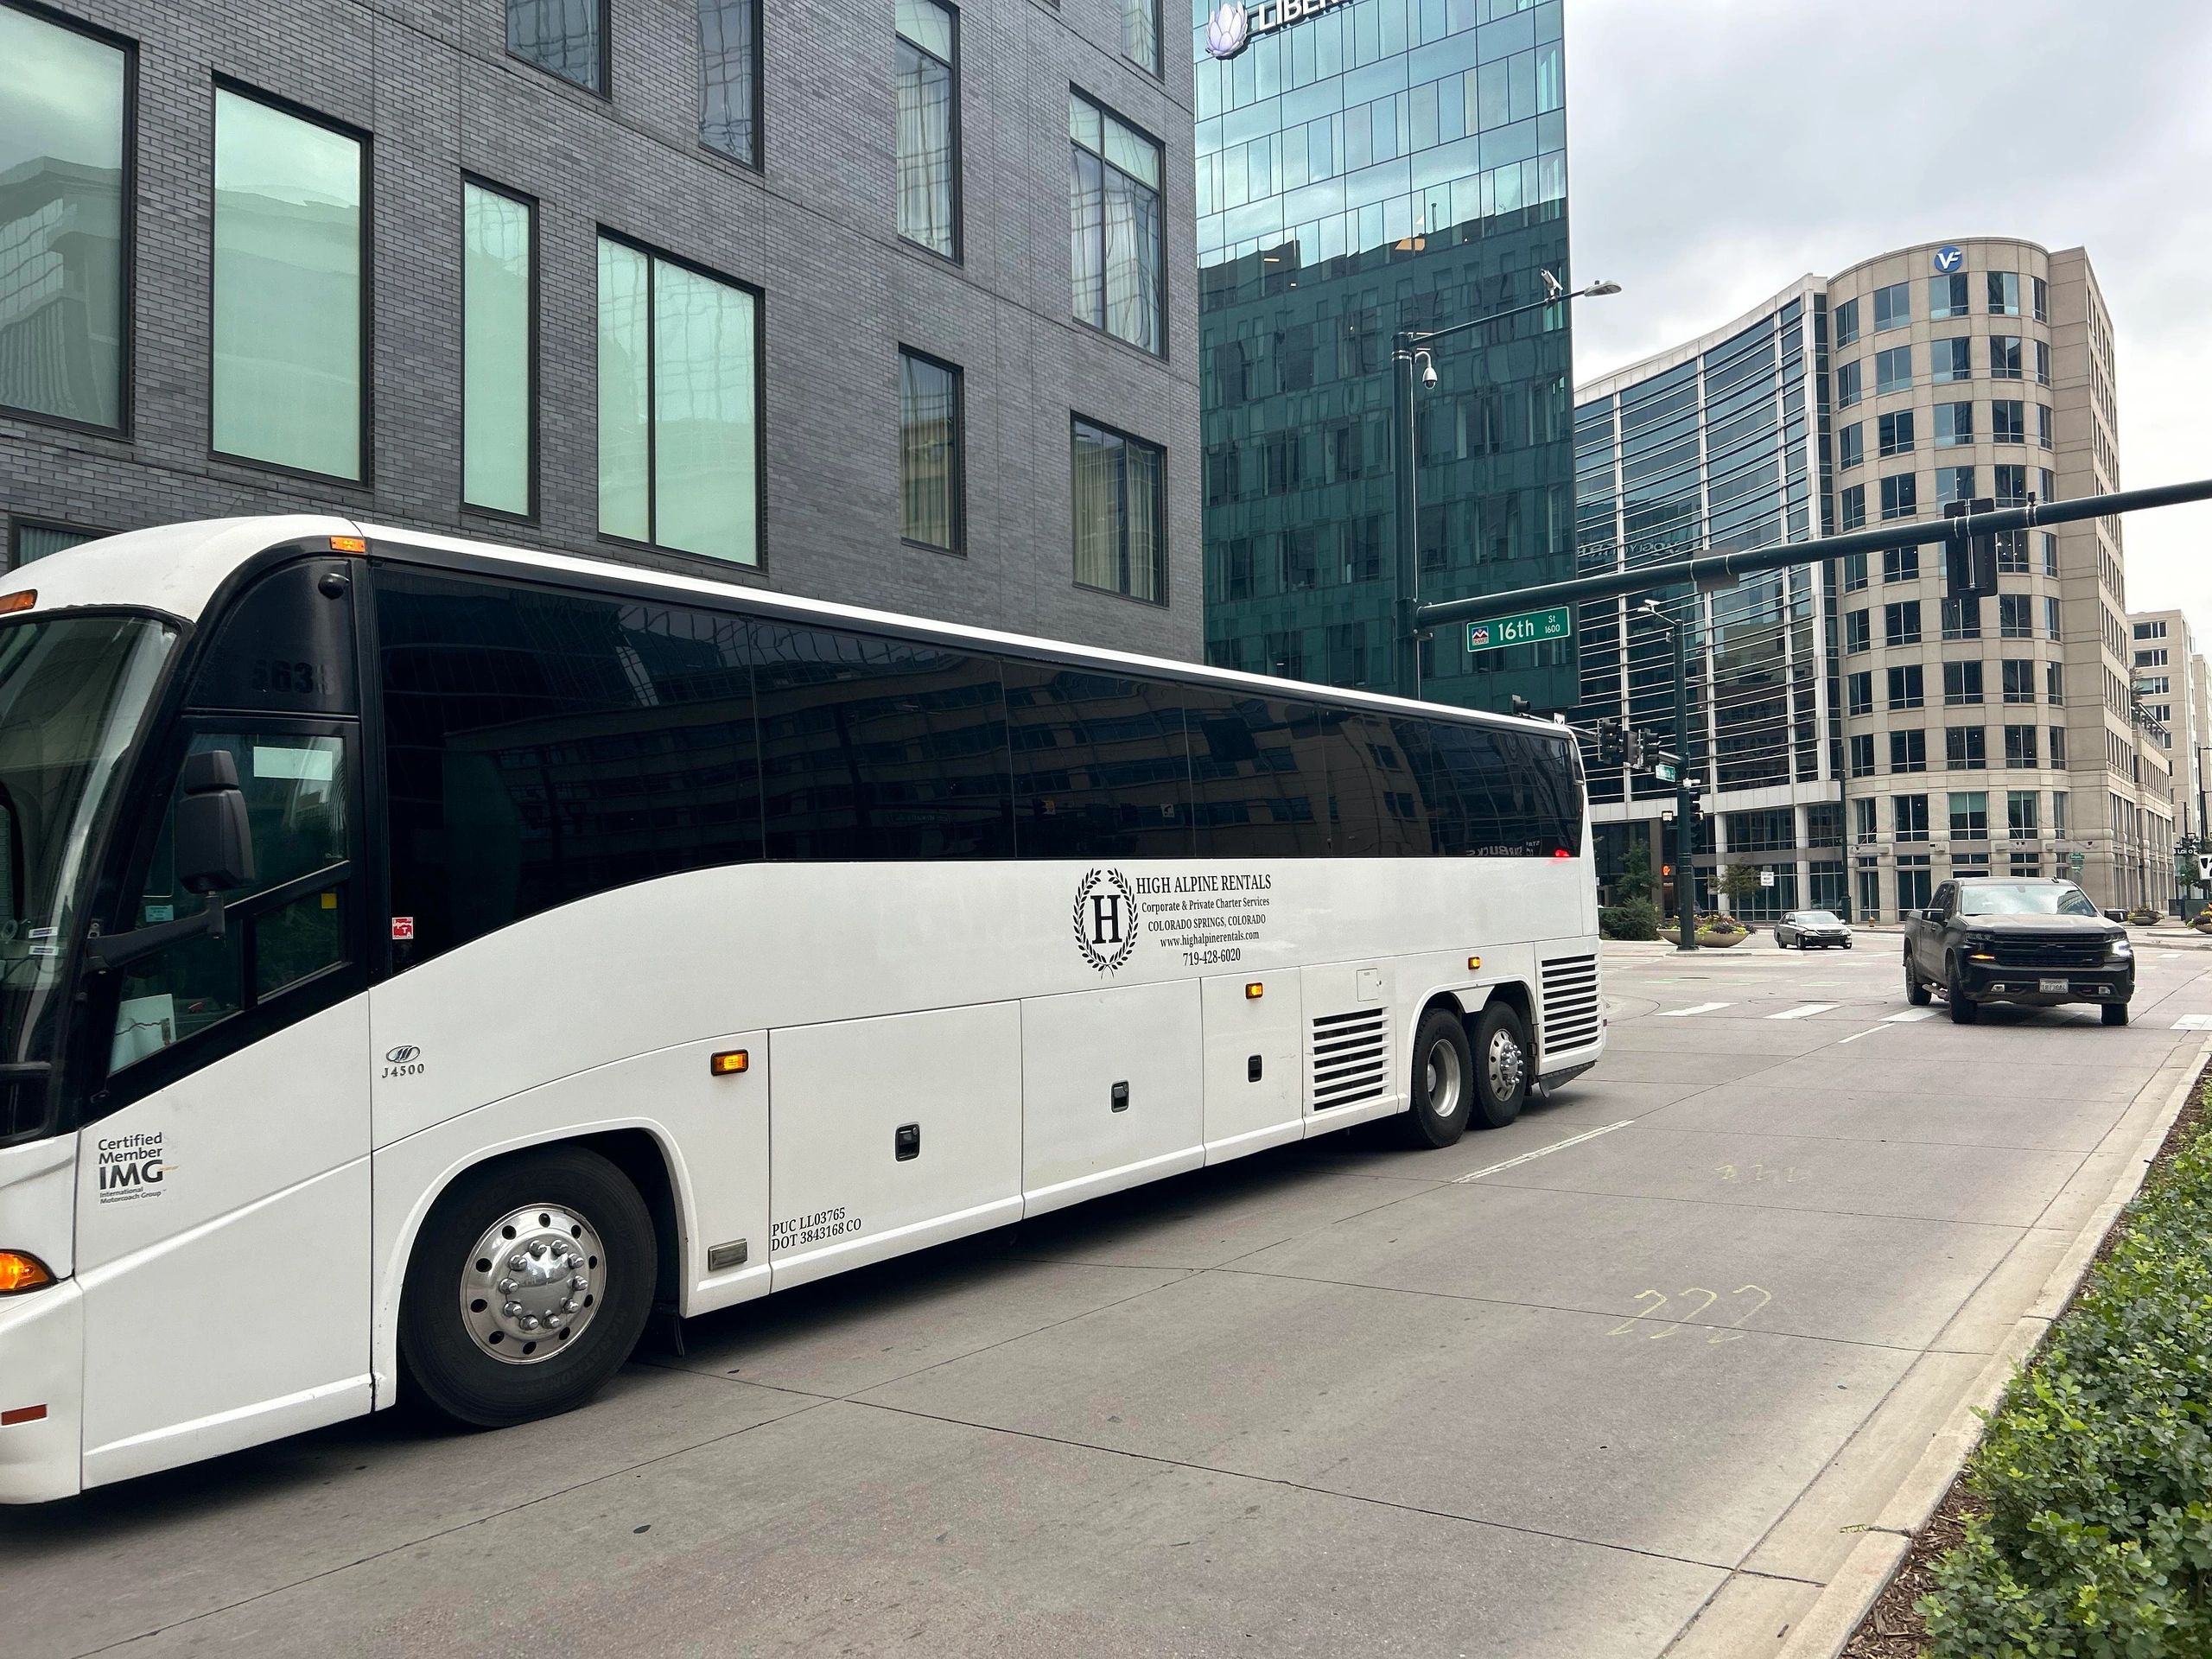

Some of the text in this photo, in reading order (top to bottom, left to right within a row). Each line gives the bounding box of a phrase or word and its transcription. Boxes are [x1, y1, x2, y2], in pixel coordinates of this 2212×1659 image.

[1937, 251, 1961, 269] VF
[1498, 615, 1556, 641] 16th St
[1544, 624, 1560, 634] 1600
[1135, 874, 1271, 894] HIGH ALPINE RENTALS
[1141, 896, 1270, 915] Corporate & Private Charter Services
[1090, 894, 1122, 944] H
[1147, 913, 1266, 932] COLORADO SPRINGS, COLORADO
[1160, 930, 1260, 948] www.highalpinerentals.com
[1182, 947, 1241, 966] 719-428-6020
[381, 1064, 425, 1078] J4500
[98, 1131, 162, 1151] Certified
[99, 1147, 162, 1165] Member
[99, 1159, 163, 1190] IMG
[99, 1186, 143, 1198] International
[99, 1193, 140, 1205] Motorcoach
[772, 1206, 846, 1236] PUC LL03765
[771, 1218, 861, 1251] DOT 3843168 CO
